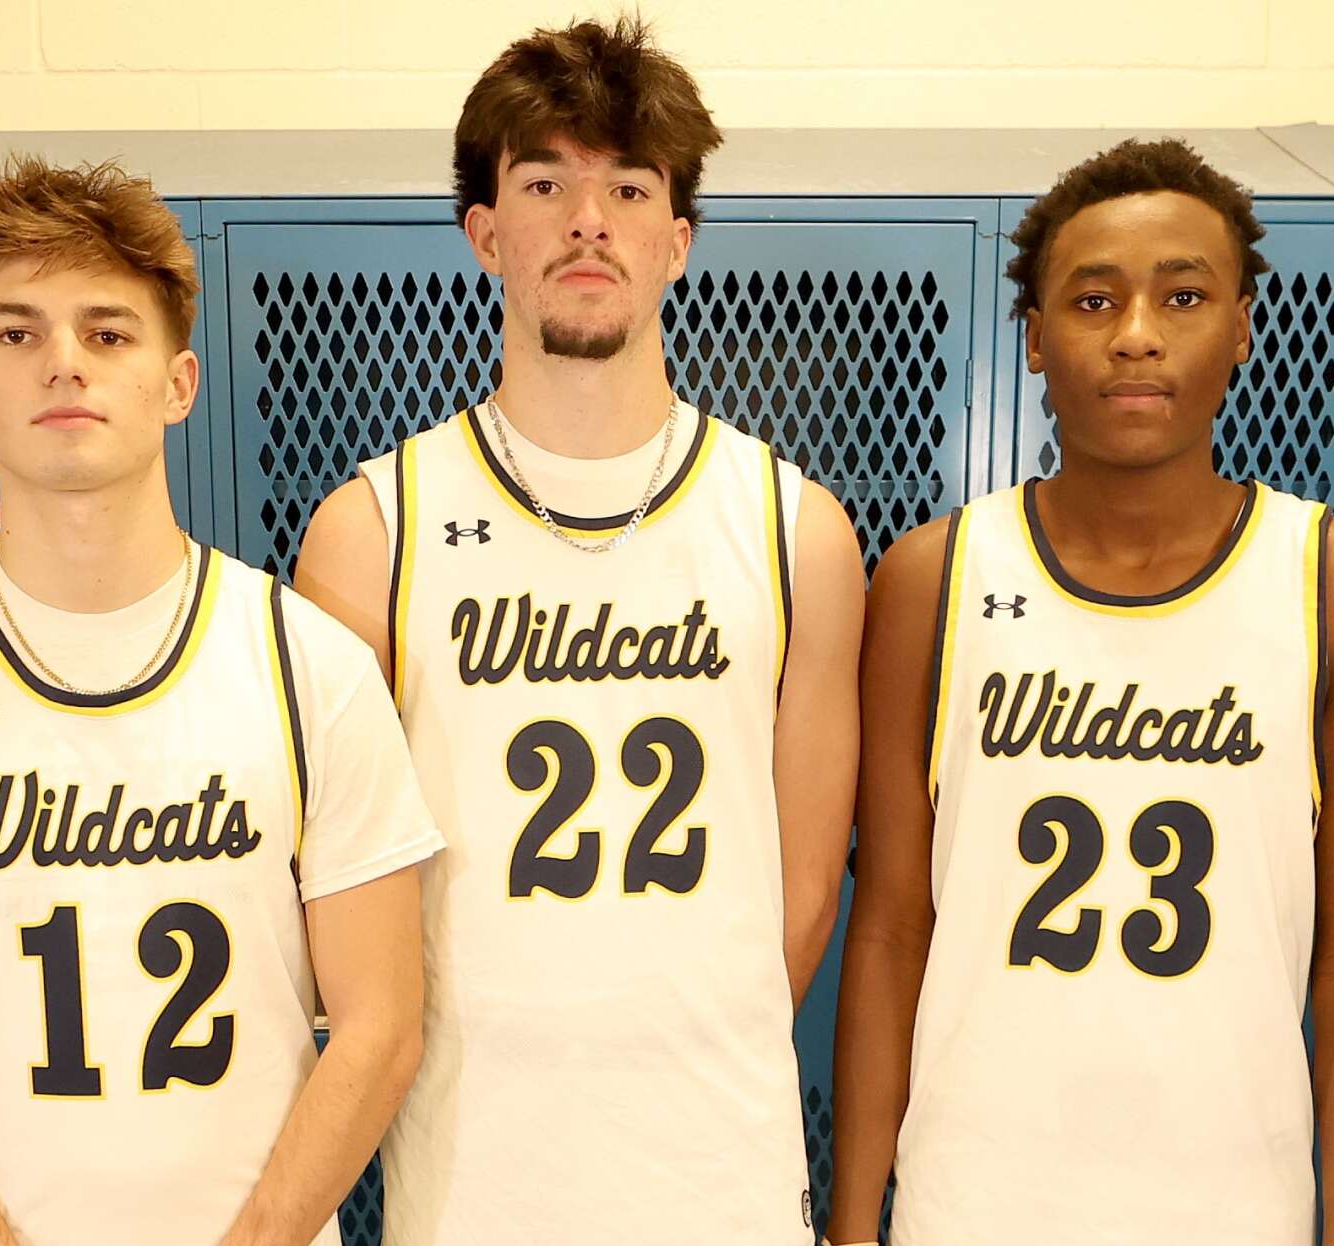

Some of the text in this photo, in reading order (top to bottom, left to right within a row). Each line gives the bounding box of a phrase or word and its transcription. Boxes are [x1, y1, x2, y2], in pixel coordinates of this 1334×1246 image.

[452, 591, 731, 686] Wildcats
[978, 669, 1264, 767] Wildcats
[504, 715, 708, 900] 22
[1006, 793, 1216, 979] 23
[19, 899, 236, 1097] 12
